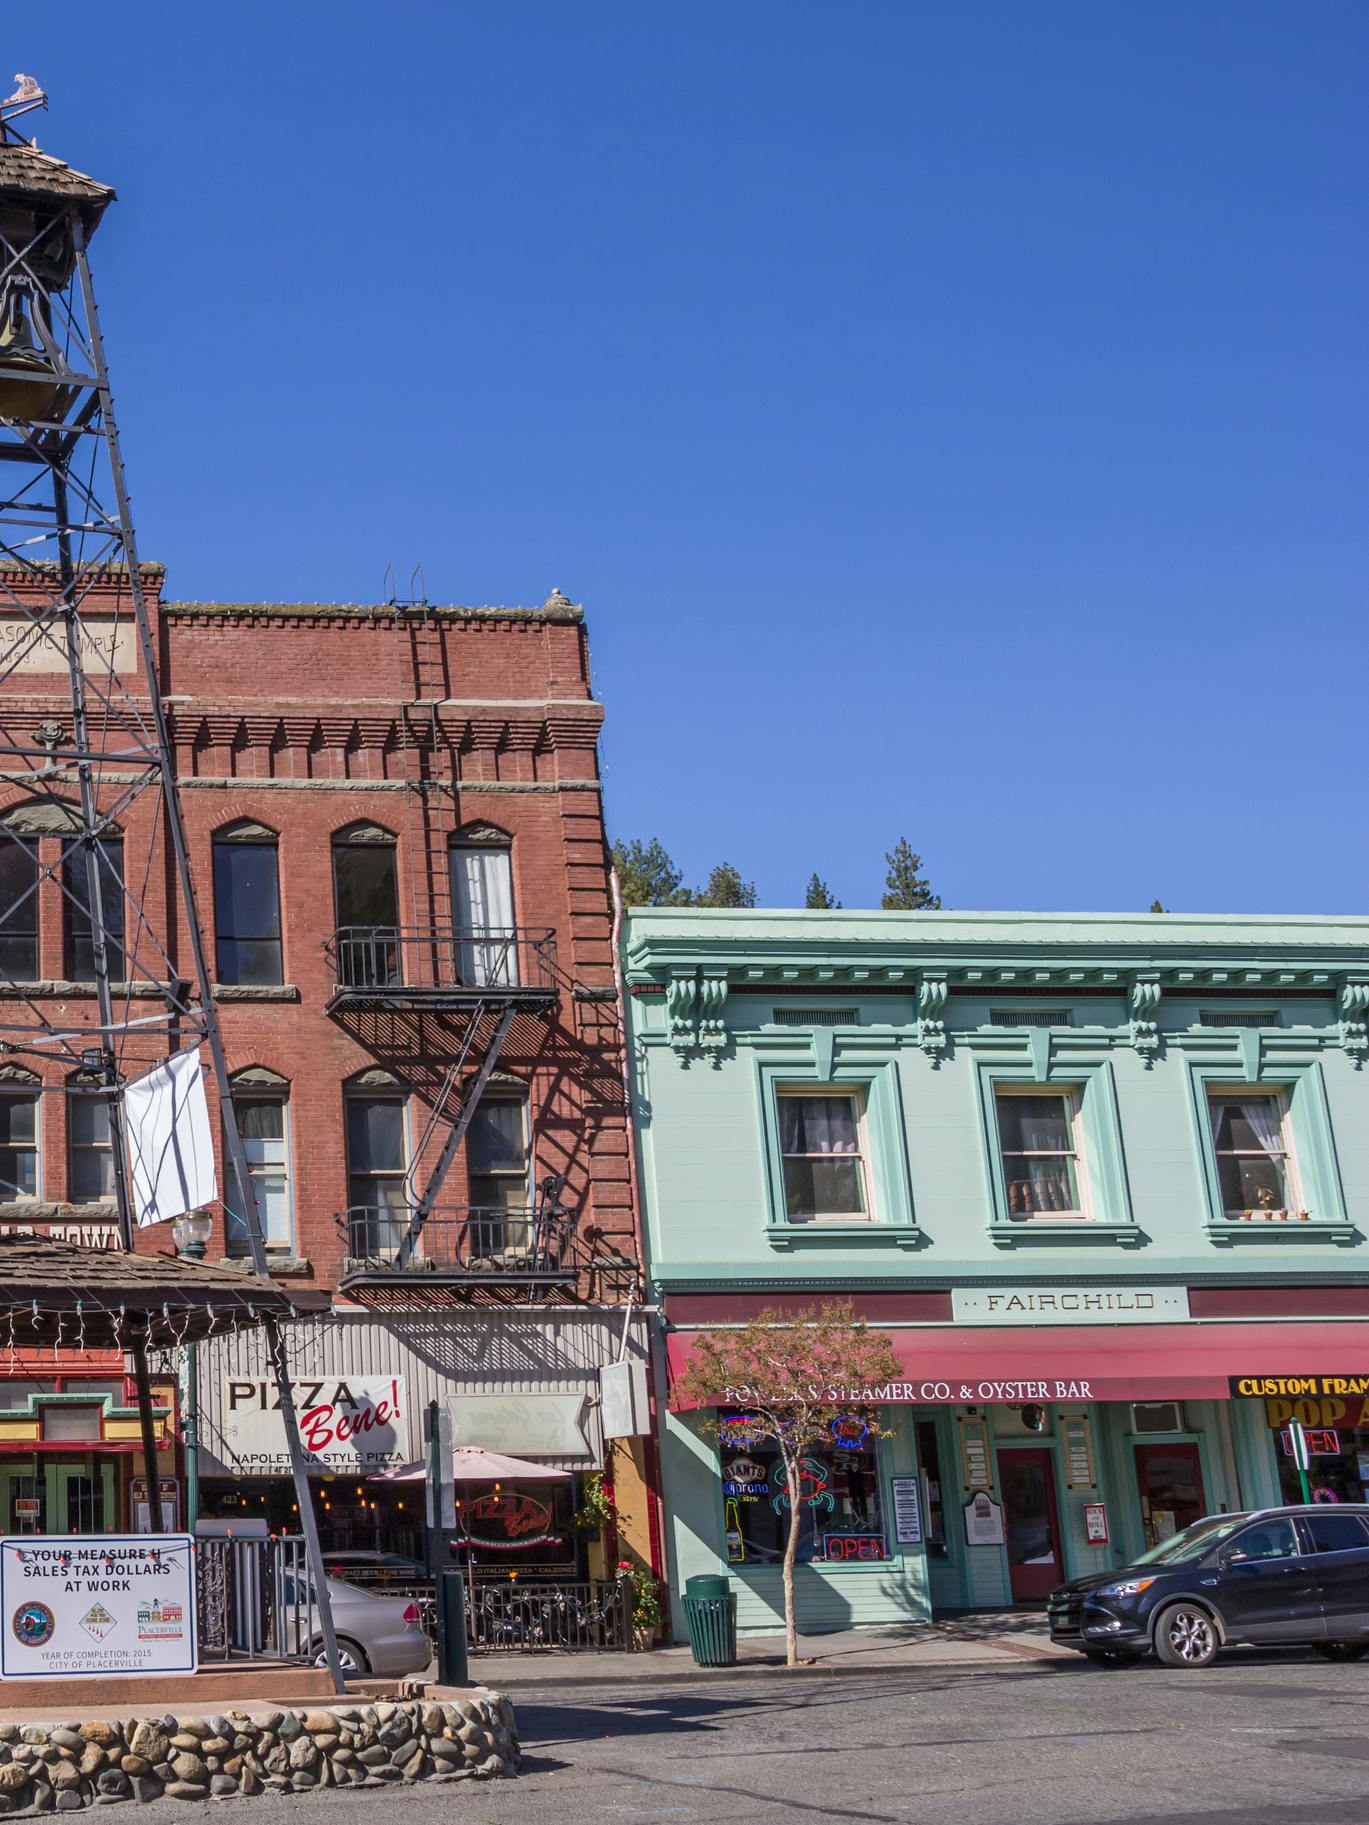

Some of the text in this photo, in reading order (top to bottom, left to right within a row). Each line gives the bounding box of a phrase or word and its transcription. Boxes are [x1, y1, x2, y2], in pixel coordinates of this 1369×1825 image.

[60, 634, 124, 654] TMPLE.
[987, 1293, 1154, 1311] FAIRCHILD
[828, 1383, 914, 1400] STEAMER
[921, 1383, 955, 1400] CO.
[960, 1384, 973, 1399] &
[978, 1382, 1048, 1400] OYSTER
[1055, 1381, 1093, 1399] BAR
[1239, 1379, 1317, 1395] CUSTOM
[229, 1382, 359, 1410] PIZZA
[300, 1380, 400, 1451] Bene!
[1267, 1398, 1346, 1428] POP
[232, 1452, 403, 1464] NAPOLETNA STYLE PIZZA
[723, 1463, 765, 1479] GIANTS
[456, 1500, 537, 1519] PIZZA
[32, 1550, 72, 1562] YOUR
[78, 1549, 145, 1561] MEASURE
[829, 1537, 885, 1560] OPEN
[23, 1563, 170, 1577] SALES TAX DOLLARS
[65, 1580, 131, 1592] AT WORK
[41, 1650, 152, 1659] YEAR OF COMPLETION: 2015
[49, 1659, 143, 1669] CITY OF PLACERVILLE
